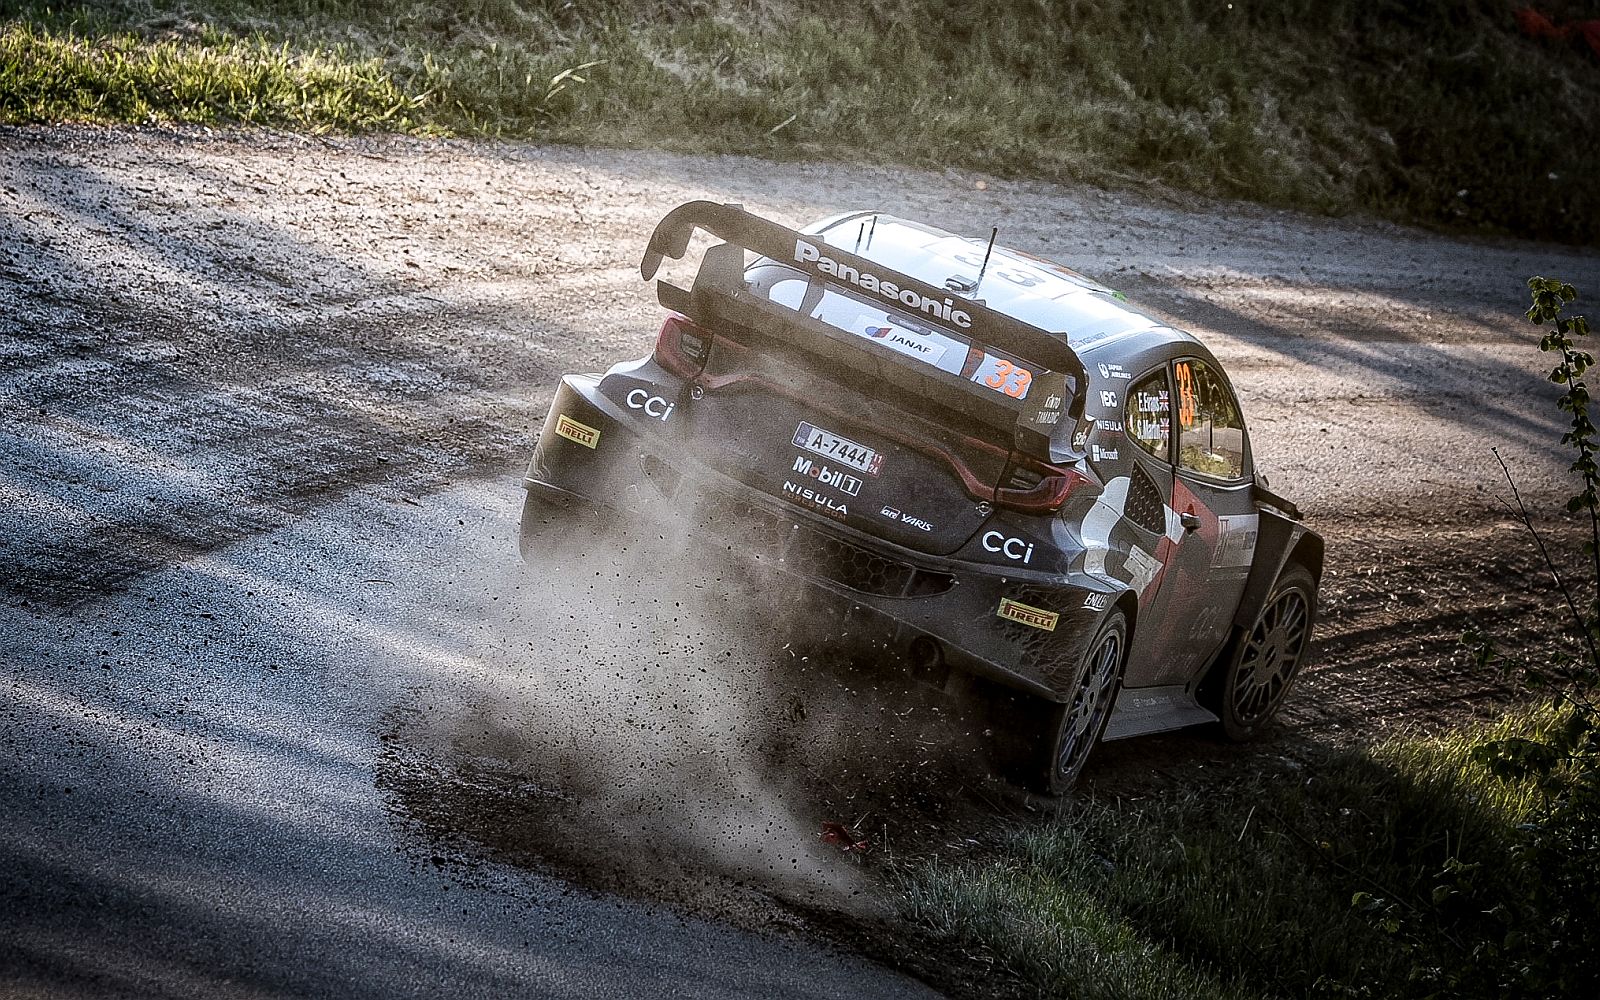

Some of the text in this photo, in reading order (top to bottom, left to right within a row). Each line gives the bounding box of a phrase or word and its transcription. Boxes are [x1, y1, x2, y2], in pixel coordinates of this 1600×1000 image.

[794, 239, 972, 328] Panasonic
[890, 335, 932, 354] JANAF
[985, 360, 1032, 398] 33
[560, 420, 595, 444] PIRELLI
[1096, 419, 1123, 432] NISULA
[812, 433, 868, 467] A-7444
[792, 456, 844, 488] Mobil
[783, 480, 847, 515] NISULA
[901, 513, 933, 532] YARIS
[1003, 603, 1054, 628] PIRELLI
